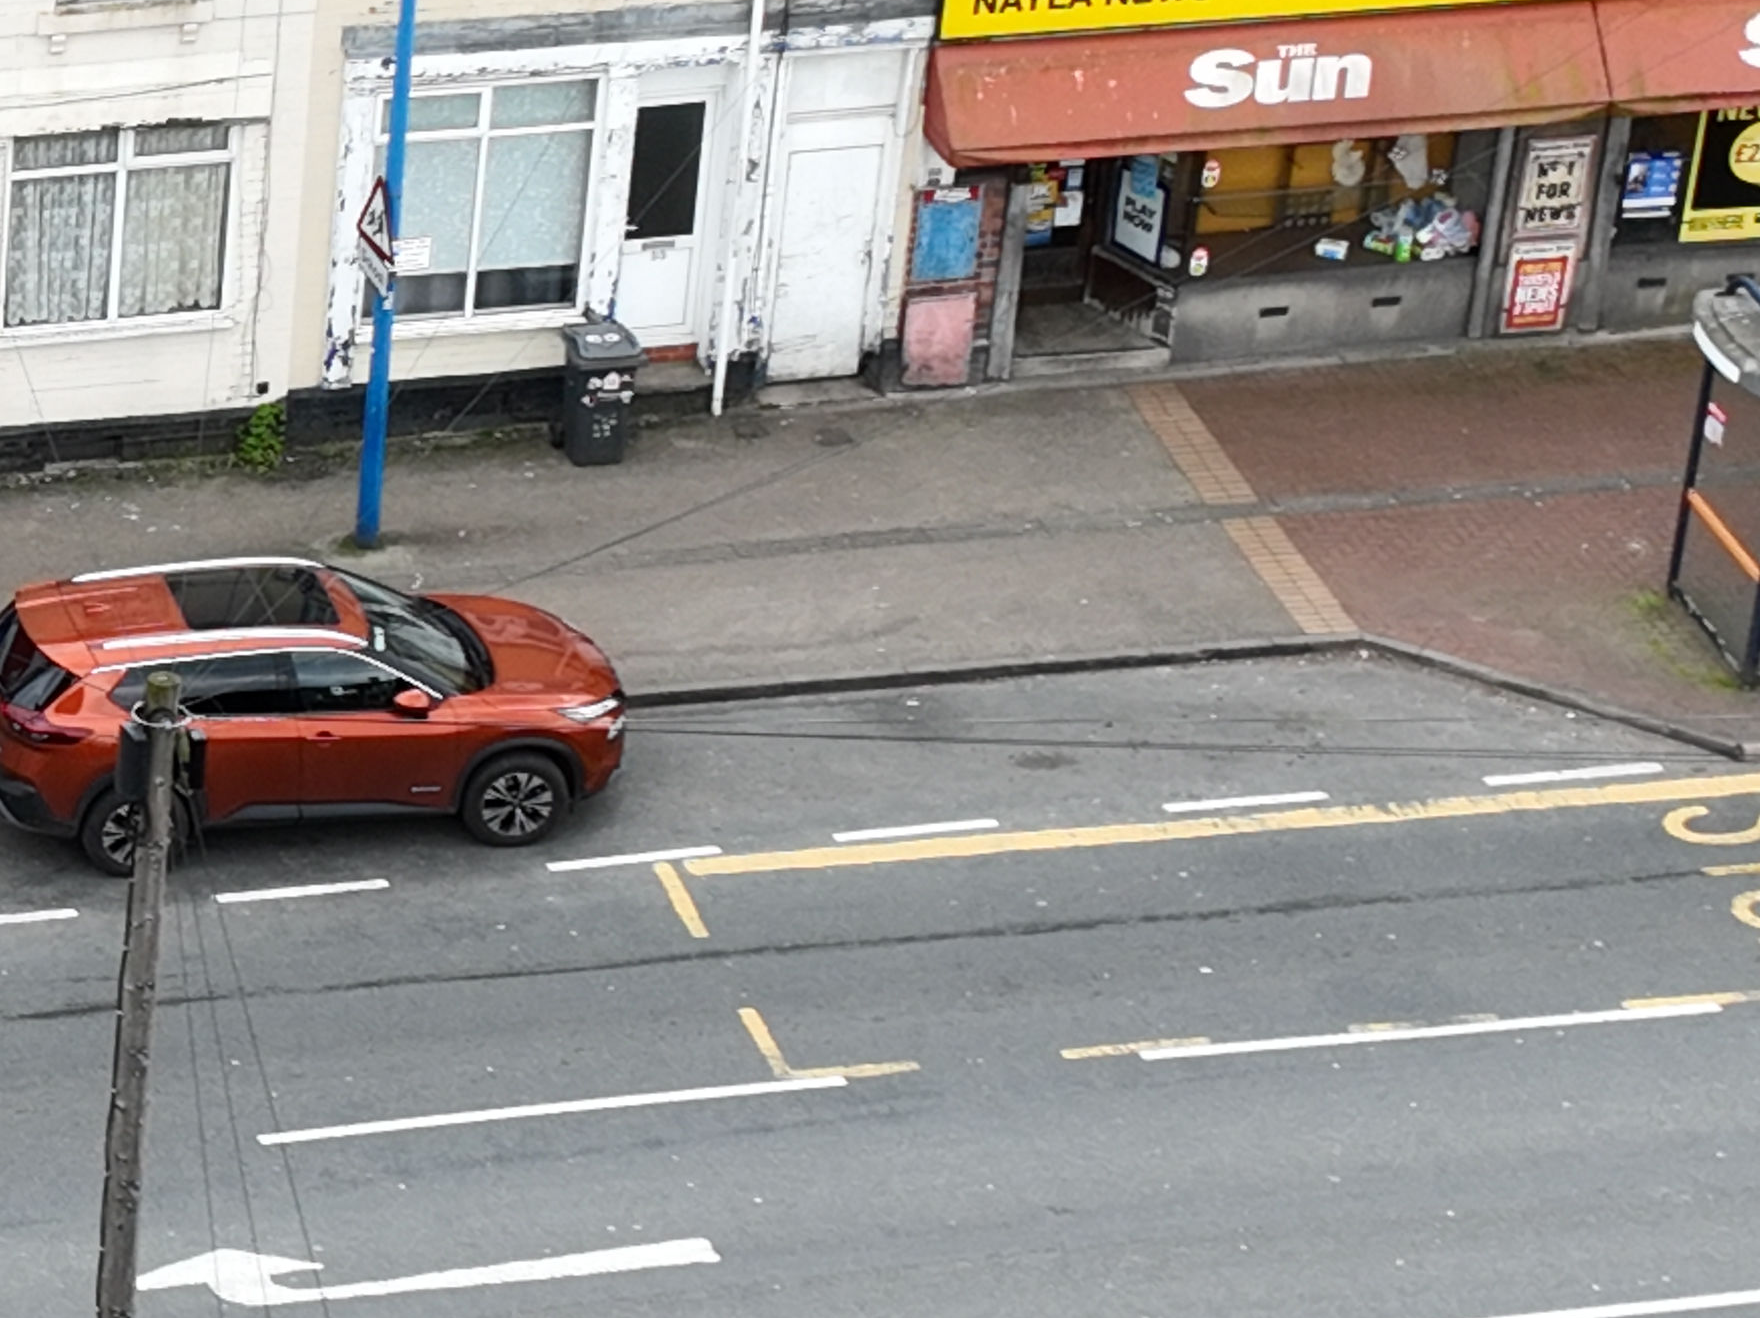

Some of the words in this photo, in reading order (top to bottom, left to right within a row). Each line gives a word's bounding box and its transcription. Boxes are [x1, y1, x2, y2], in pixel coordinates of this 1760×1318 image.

[1277, 42, 1318, 59] THE
[1183, 48, 1373, 108] Sun
[1535, 181, 1572, 200] FOR
[1125, 195, 1157, 219] PLAY
[1122, 211, 1154, 233] NOW
